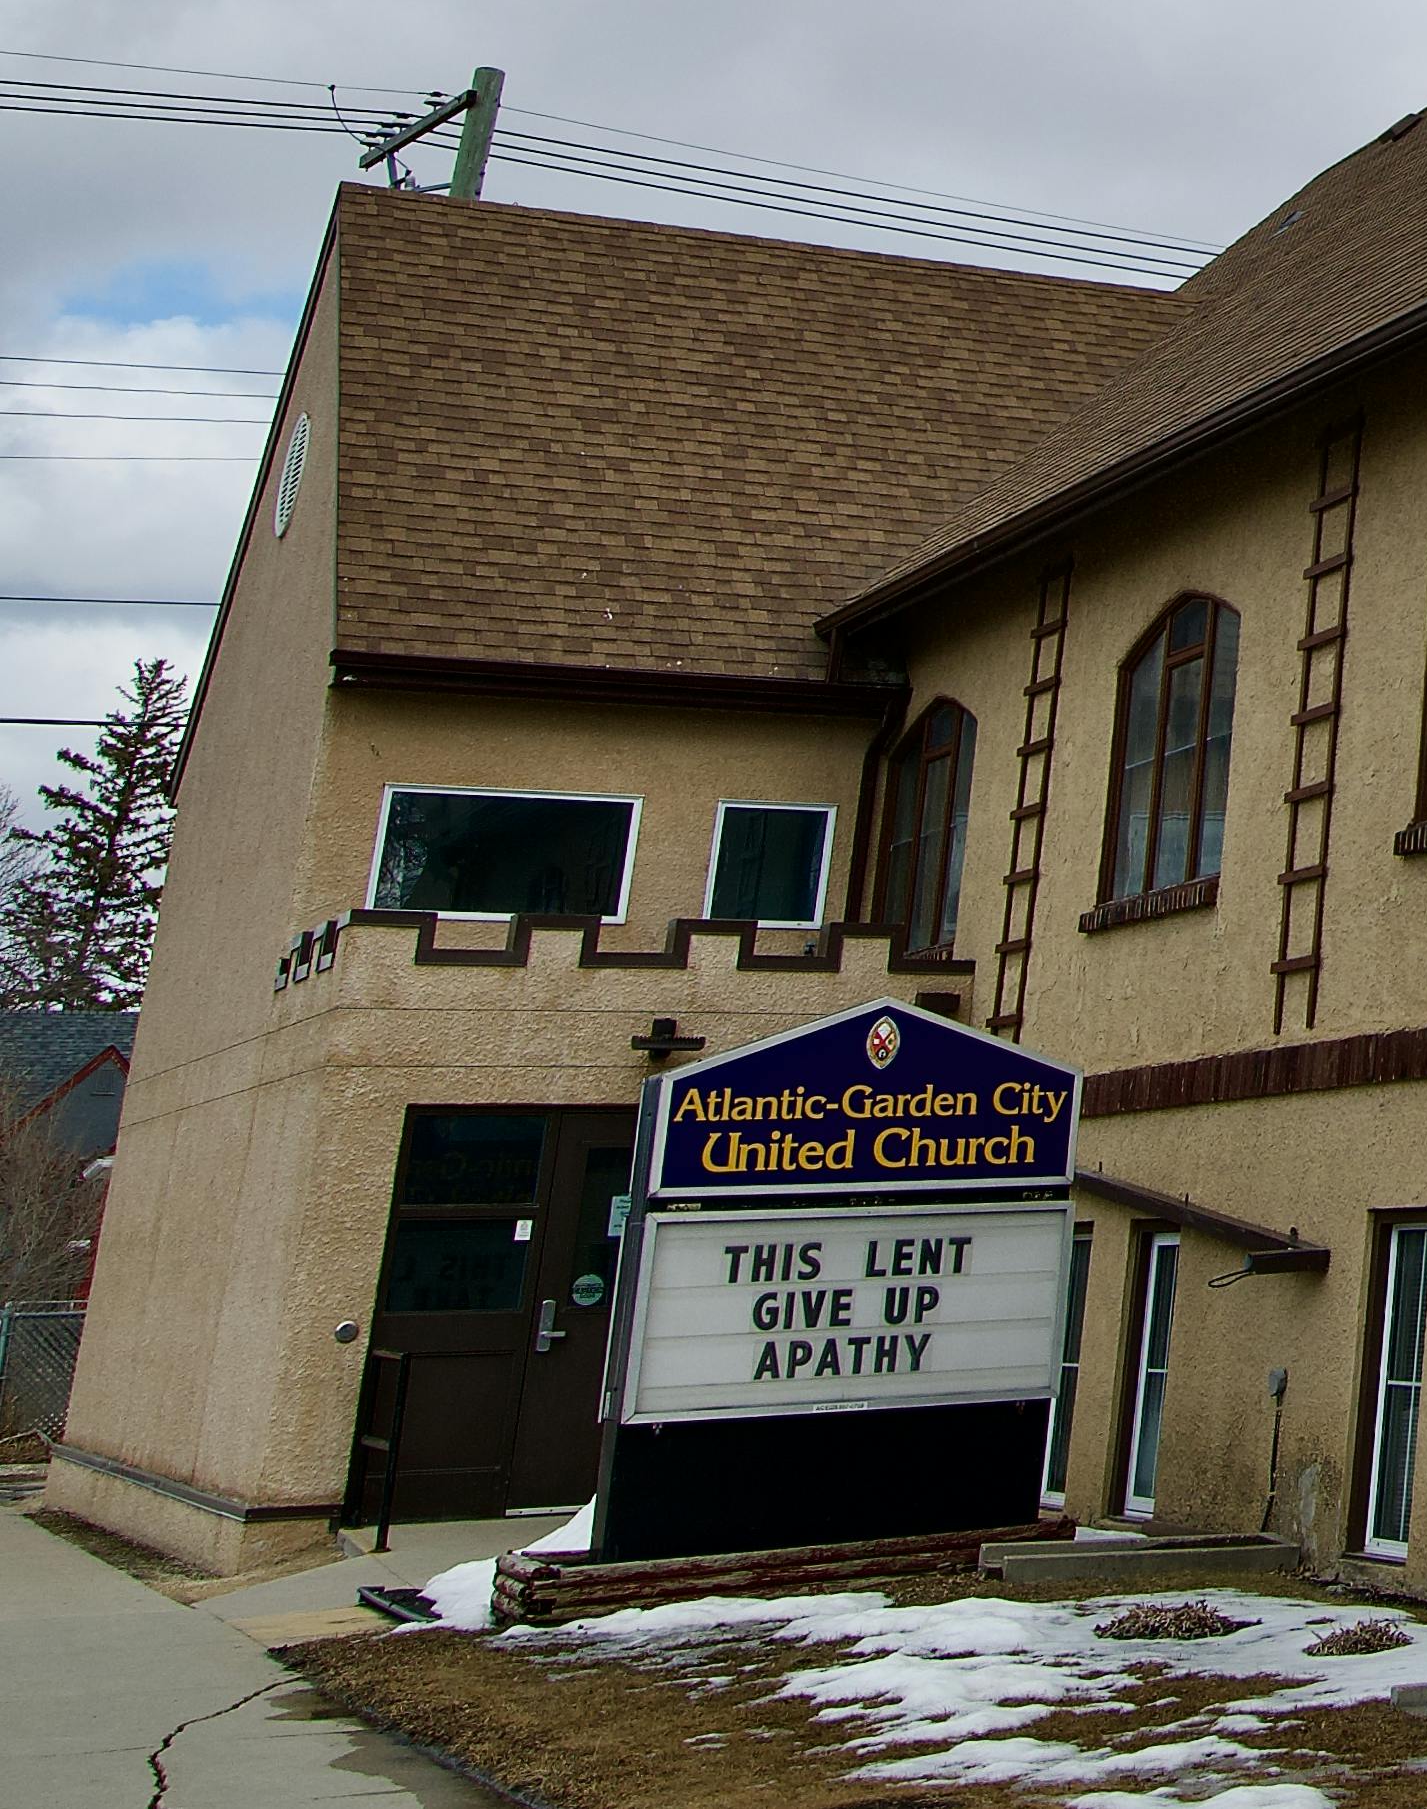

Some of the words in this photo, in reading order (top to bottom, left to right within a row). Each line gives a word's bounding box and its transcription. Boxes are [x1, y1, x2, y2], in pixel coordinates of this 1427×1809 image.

[993, 1082, 1068, 1124] City
[701, 1123, 855, 1173] United
[873, 1125, 1035, 1171] Church
[724, 1242, 822, 1284] THIS
[864, 1237, 973, 1278] LENT
[752, 1288, 853, 1331] GIVE
[884, 1285, 940, 1325] UP
[753, 1334, 933, 1381] APATHY
